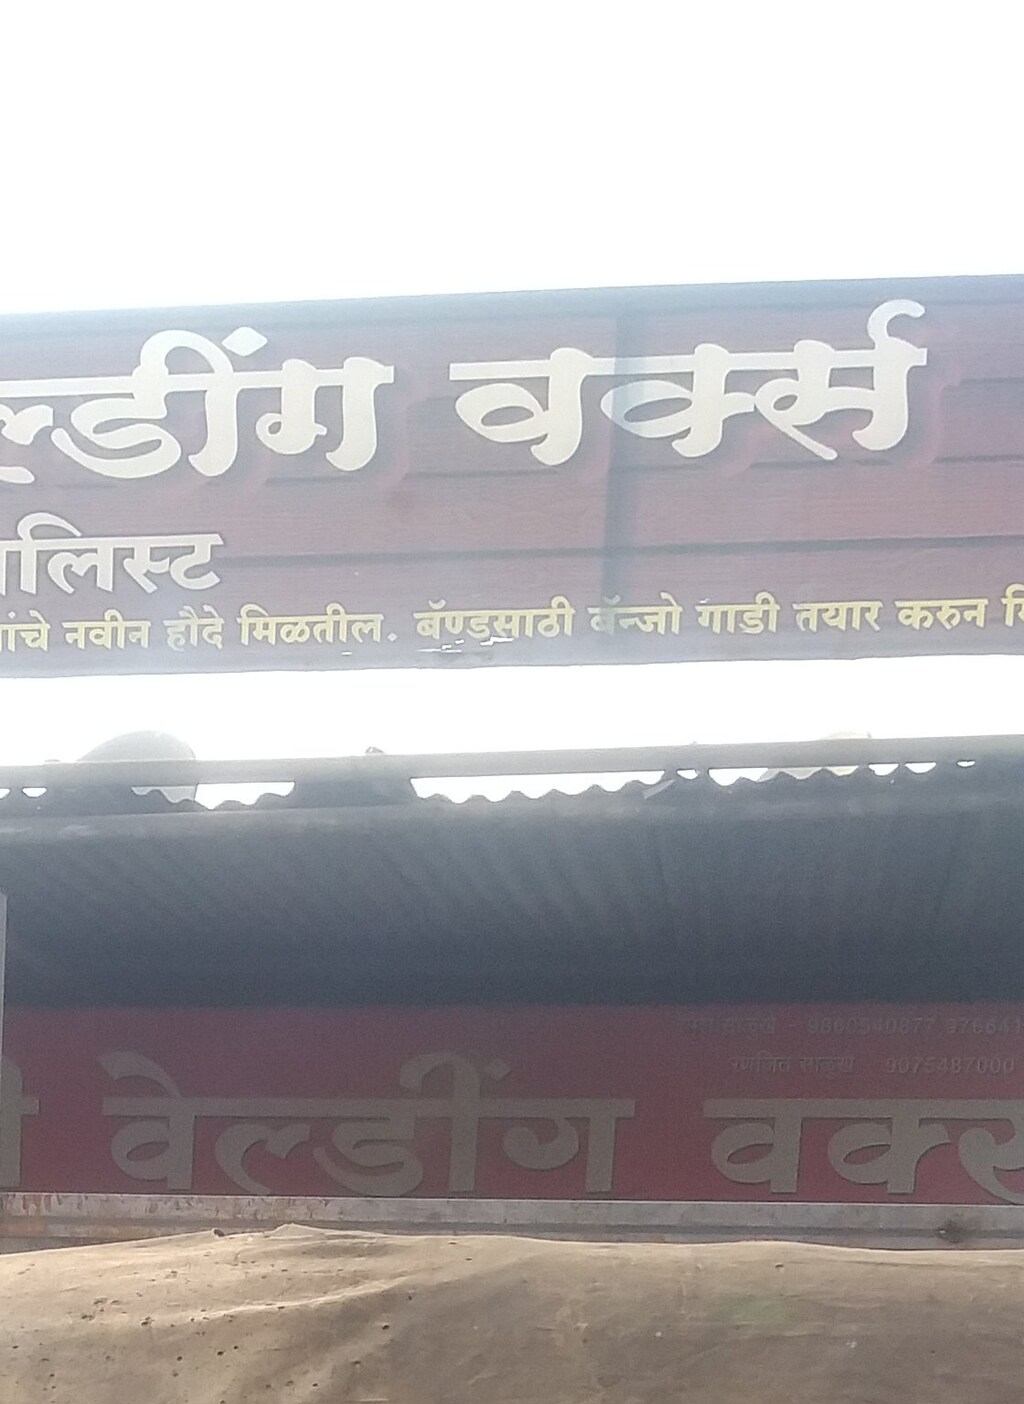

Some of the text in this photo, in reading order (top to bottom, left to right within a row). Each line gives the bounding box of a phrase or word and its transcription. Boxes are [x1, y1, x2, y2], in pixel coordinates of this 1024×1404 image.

[449, 300, 928, 466] वर्क्स
[62, 609, 151, 650] नवीन
[163, 605, 225, 651] हौदे
[695, 591, 780, 635] गाडी
[792, 600, 883, 632] तयार
[894, 598, 989, 631] करुन
[97, 1050, 634, 1197] वेल्डींग
